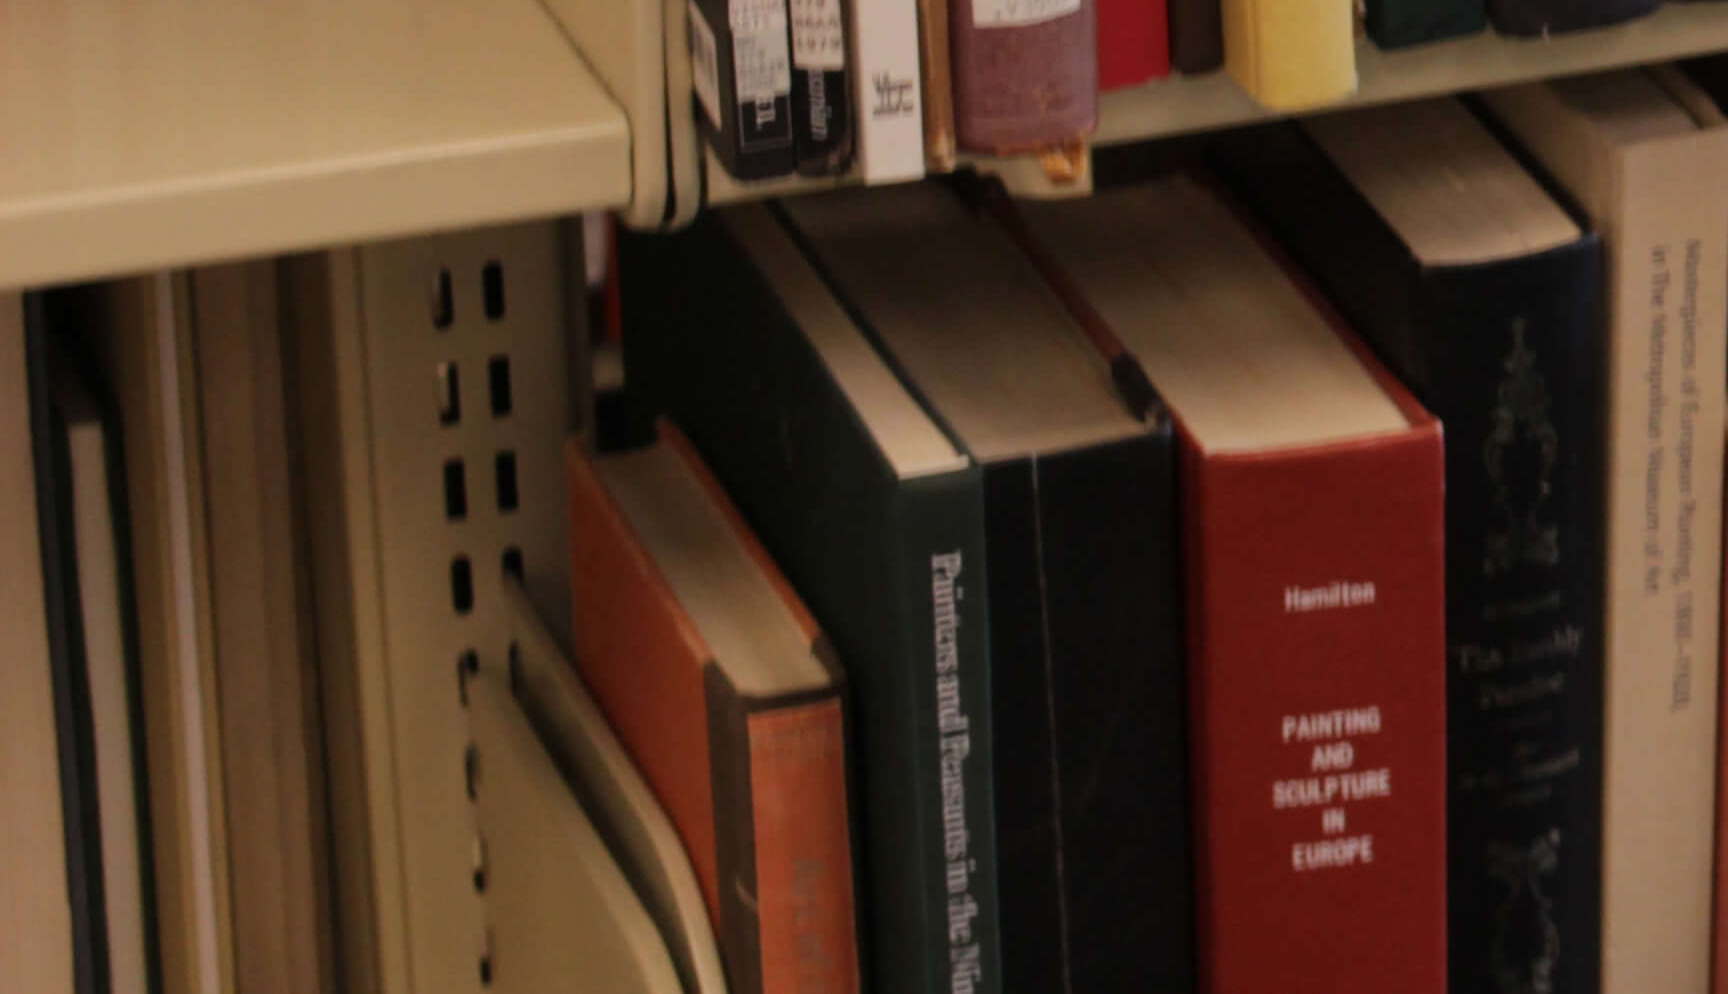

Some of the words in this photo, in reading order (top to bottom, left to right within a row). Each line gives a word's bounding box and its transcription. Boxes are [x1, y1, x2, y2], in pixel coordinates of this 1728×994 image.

[1651, 243, 1671, 268] in
[1678, 238, 1704, 374] Masterpieces
[1643, 312, 1670, 442] Metropolitan
[1681, 376, 1702, 399] of
[1674, 399, 1702, 496] European
[1643, 445, 1666, 534] Museum
[1644, 537, 1665, 562] of
[1284, 579, 1377, 615] Hamilton
[1642, 564, 1664, 600] Art
[930, 549, 967, 674] Painters
[936, 674, 971, 733] and
[1281, 704, 1383, 744] PAINTING
[1310, 740, 1356, 773] AND
[936, 733, 973, 859] Peasants
[1271, 767, 1393, 810] SCULPTURE
[1320, 808, 1348, 836] IN
[1290, 833, 1375, 873] EUROPE
[945, 857, 977, 894] in
[948, 893, 980, 944] the
